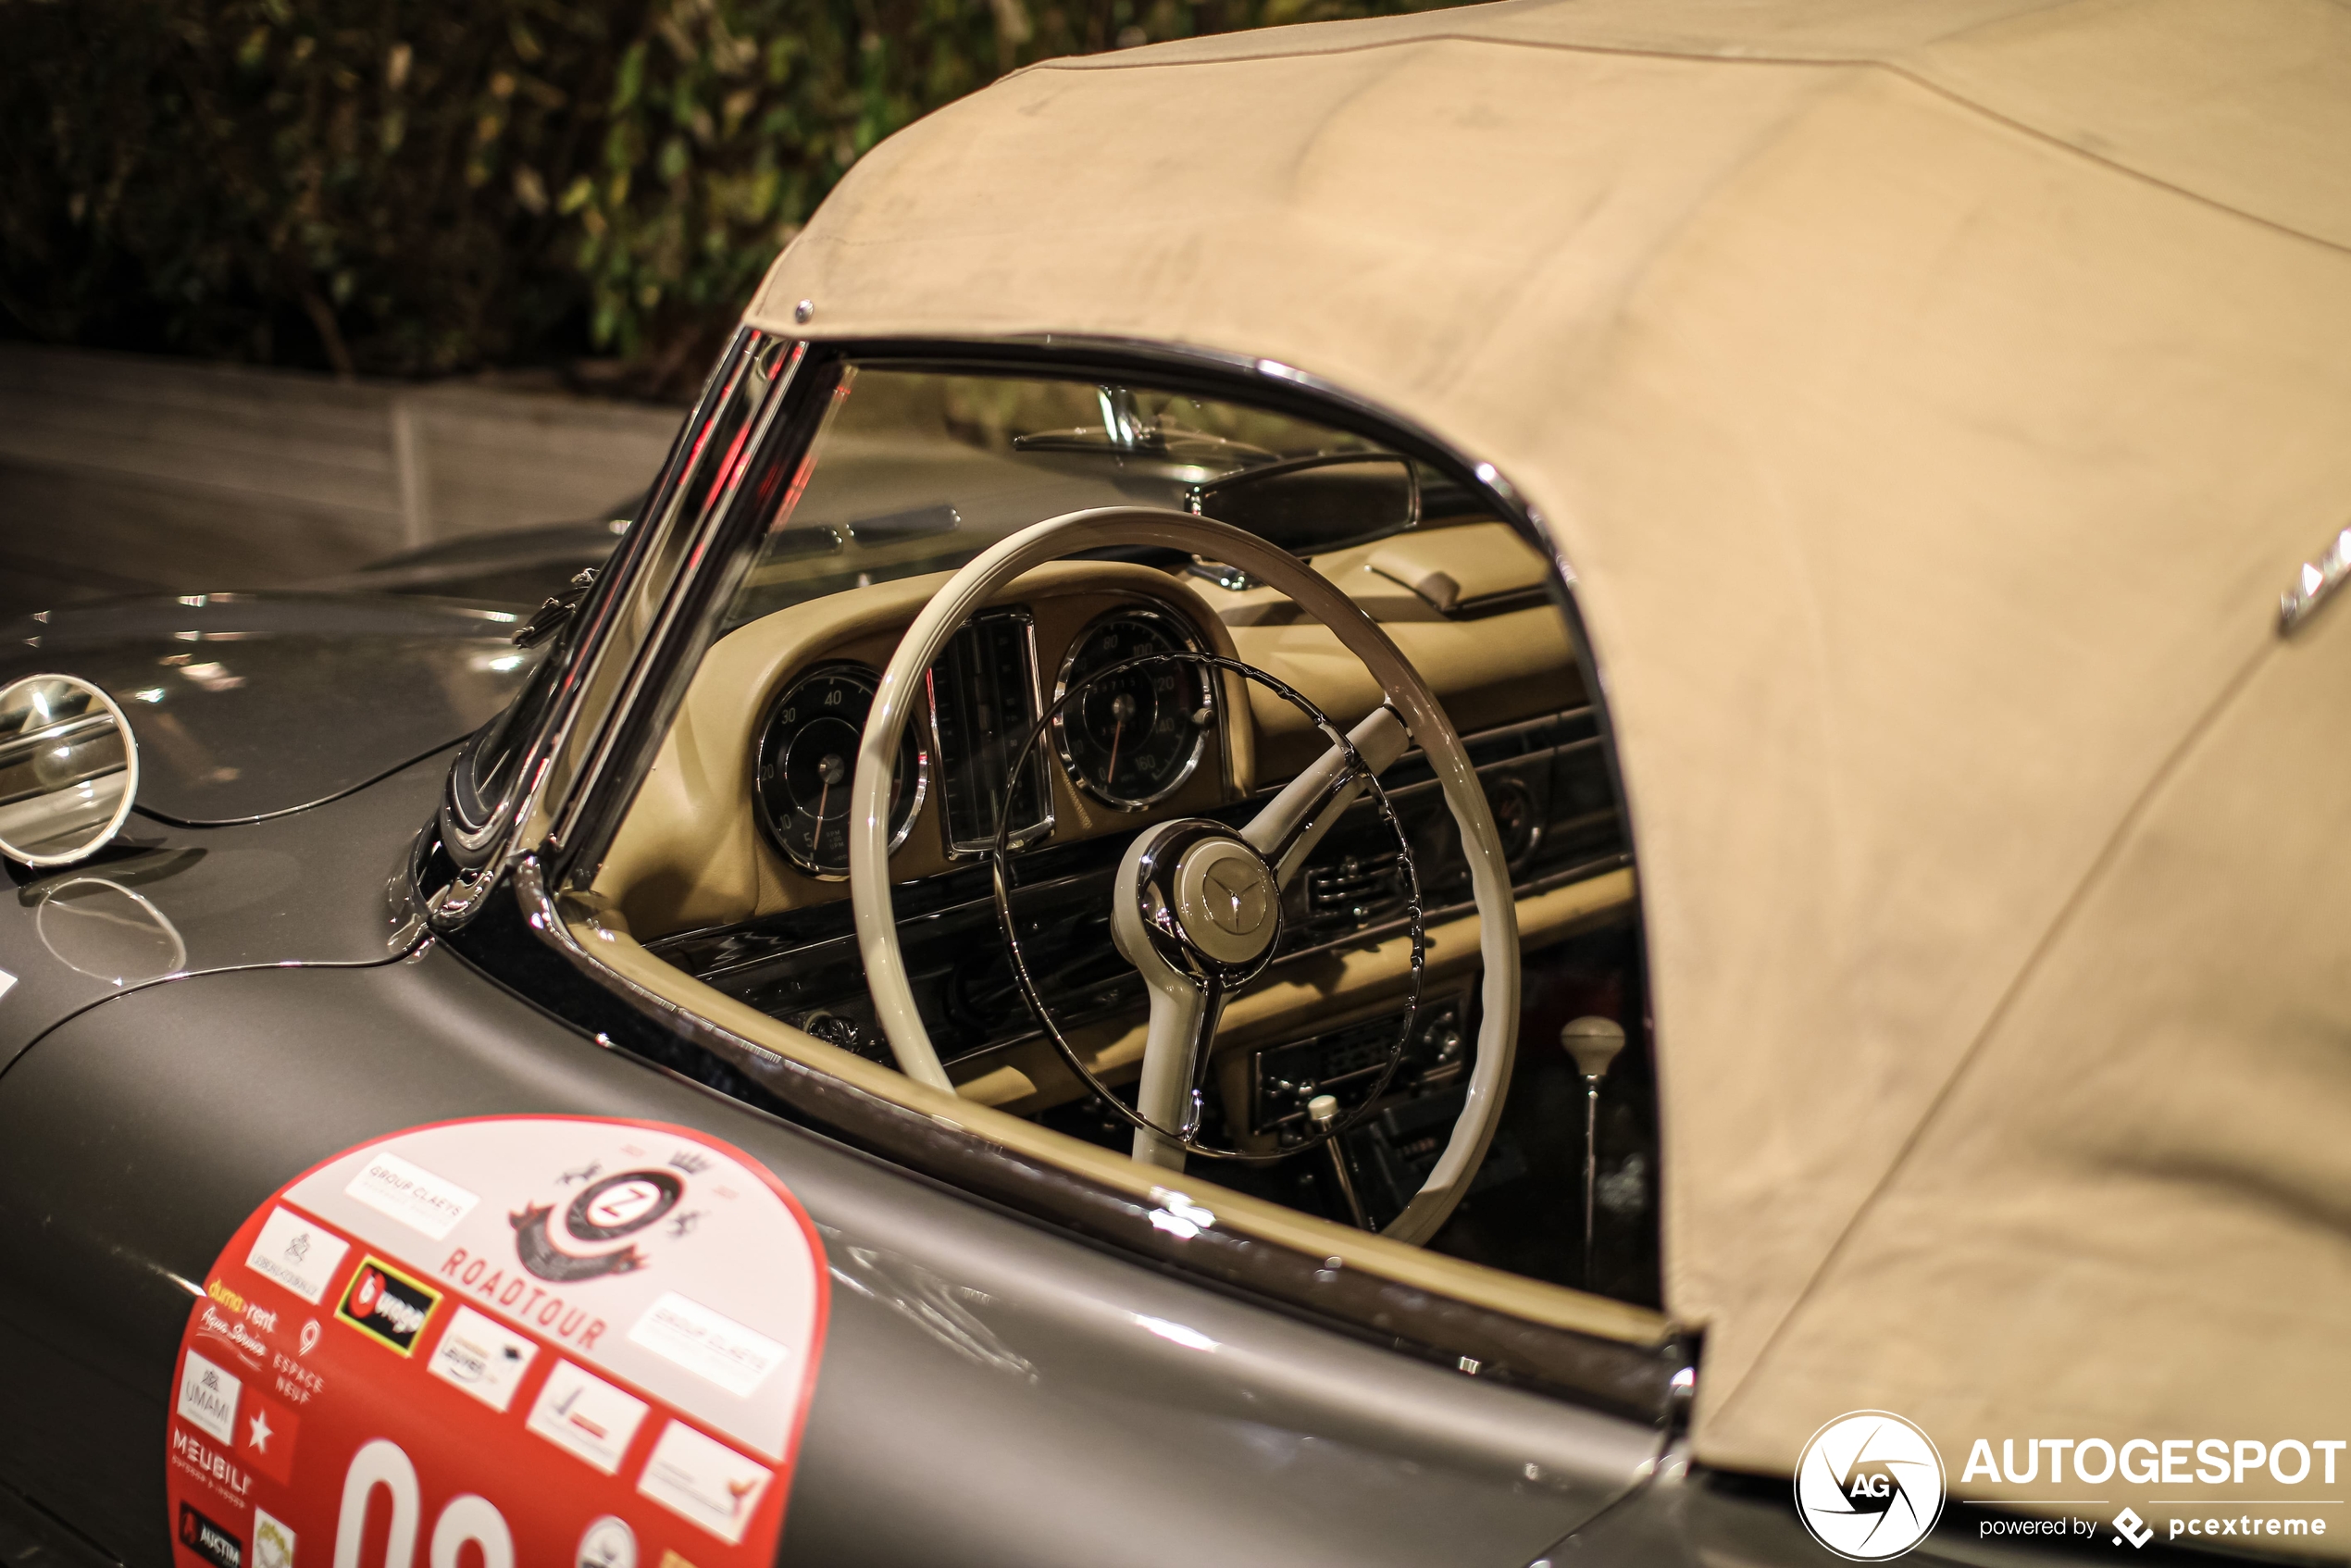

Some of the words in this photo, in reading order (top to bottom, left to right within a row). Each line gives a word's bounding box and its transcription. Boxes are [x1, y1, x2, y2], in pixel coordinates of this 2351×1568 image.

[1103, 634, 1118, 649] 80
[1133, 643, 1152, 656] 100
[1153, 676, 1175, 691] 120
[824, 691, 842, 706] 40
[781, 707, 796, 725] 30
[1154, 718, 1175, 735] 140
[1073, 739, 1084, 755] 20
[1136, 754, 1156, 770] 160
[762, 764, 775, 781] 20
[1098, 767, 1106, 781] 0
[780, 814, 792, 830] 10
[803, 832, 814, 848] 5
[826, 829, 841, 839] RPM
[829, 841, 845, 851] UPM
[369, 1165, 414, 1189] GROUP
[413, 1187, 463, 1216] CLAEYS
[207, 1277, 243, 1313] duma
[245, 1304, 278, 1334] rent
[441, 1247, 607, 1350] ROADTOUR
[272, 1352, 325, 1394] ESPACE
[185, 1381, 230, 1425] UMAMI
